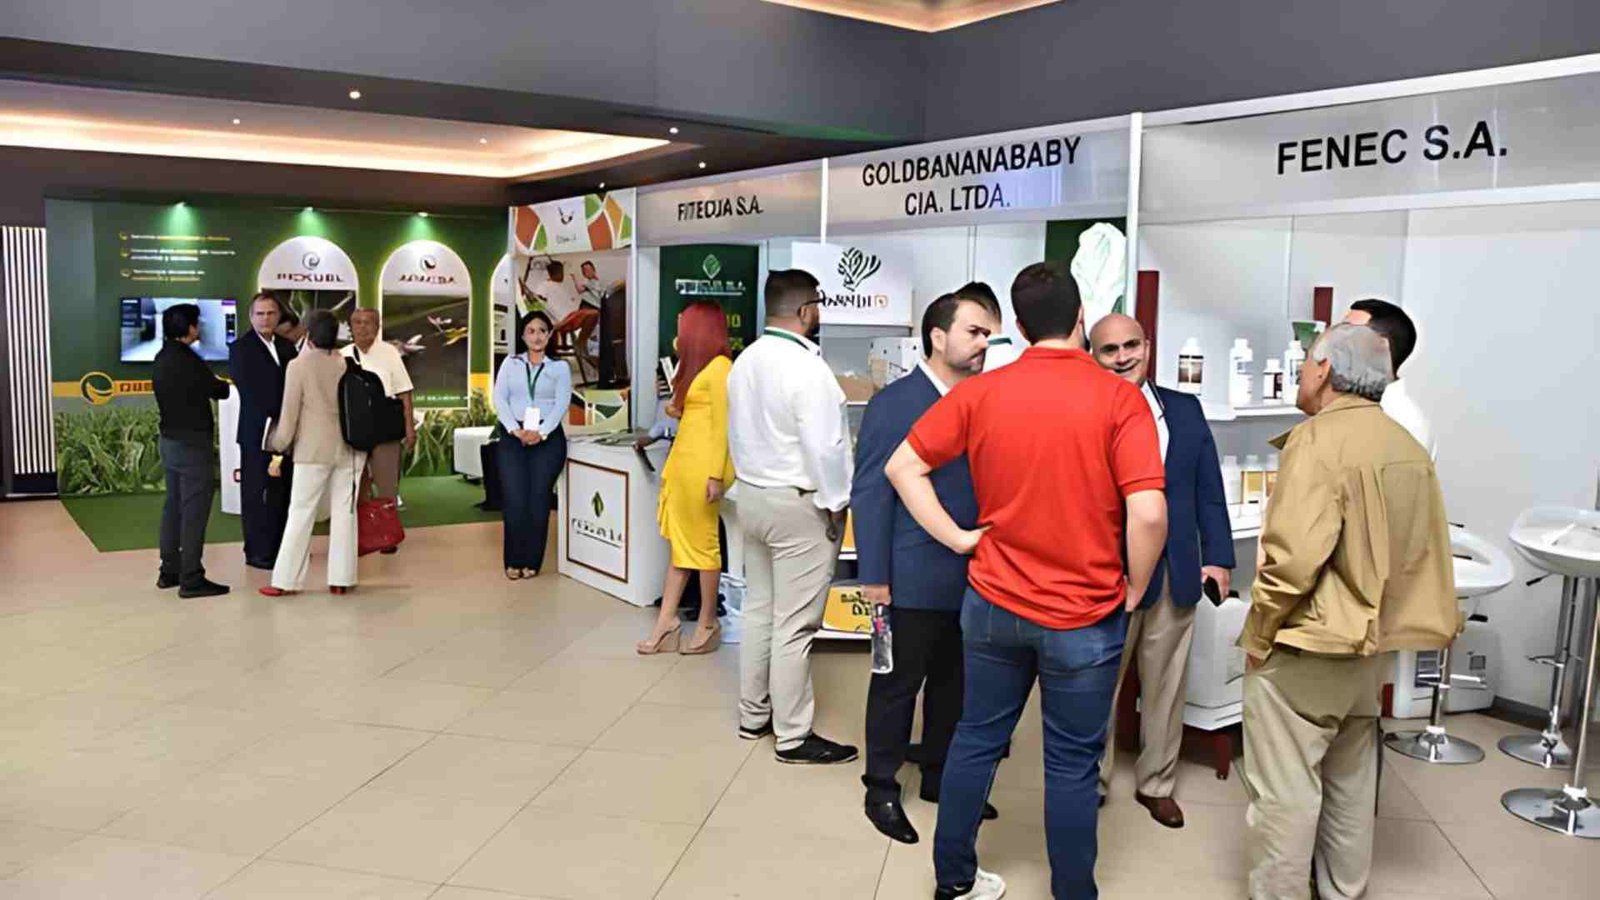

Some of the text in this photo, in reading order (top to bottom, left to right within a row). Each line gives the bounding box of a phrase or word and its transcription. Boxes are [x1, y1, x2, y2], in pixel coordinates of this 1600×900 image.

[862, 136, 1082, 187] GOLDBANANABABY
[1277, 120, 1508, 175] FENEC S.A.
[905, 183, 1011, 216] CIA. LTDA.
